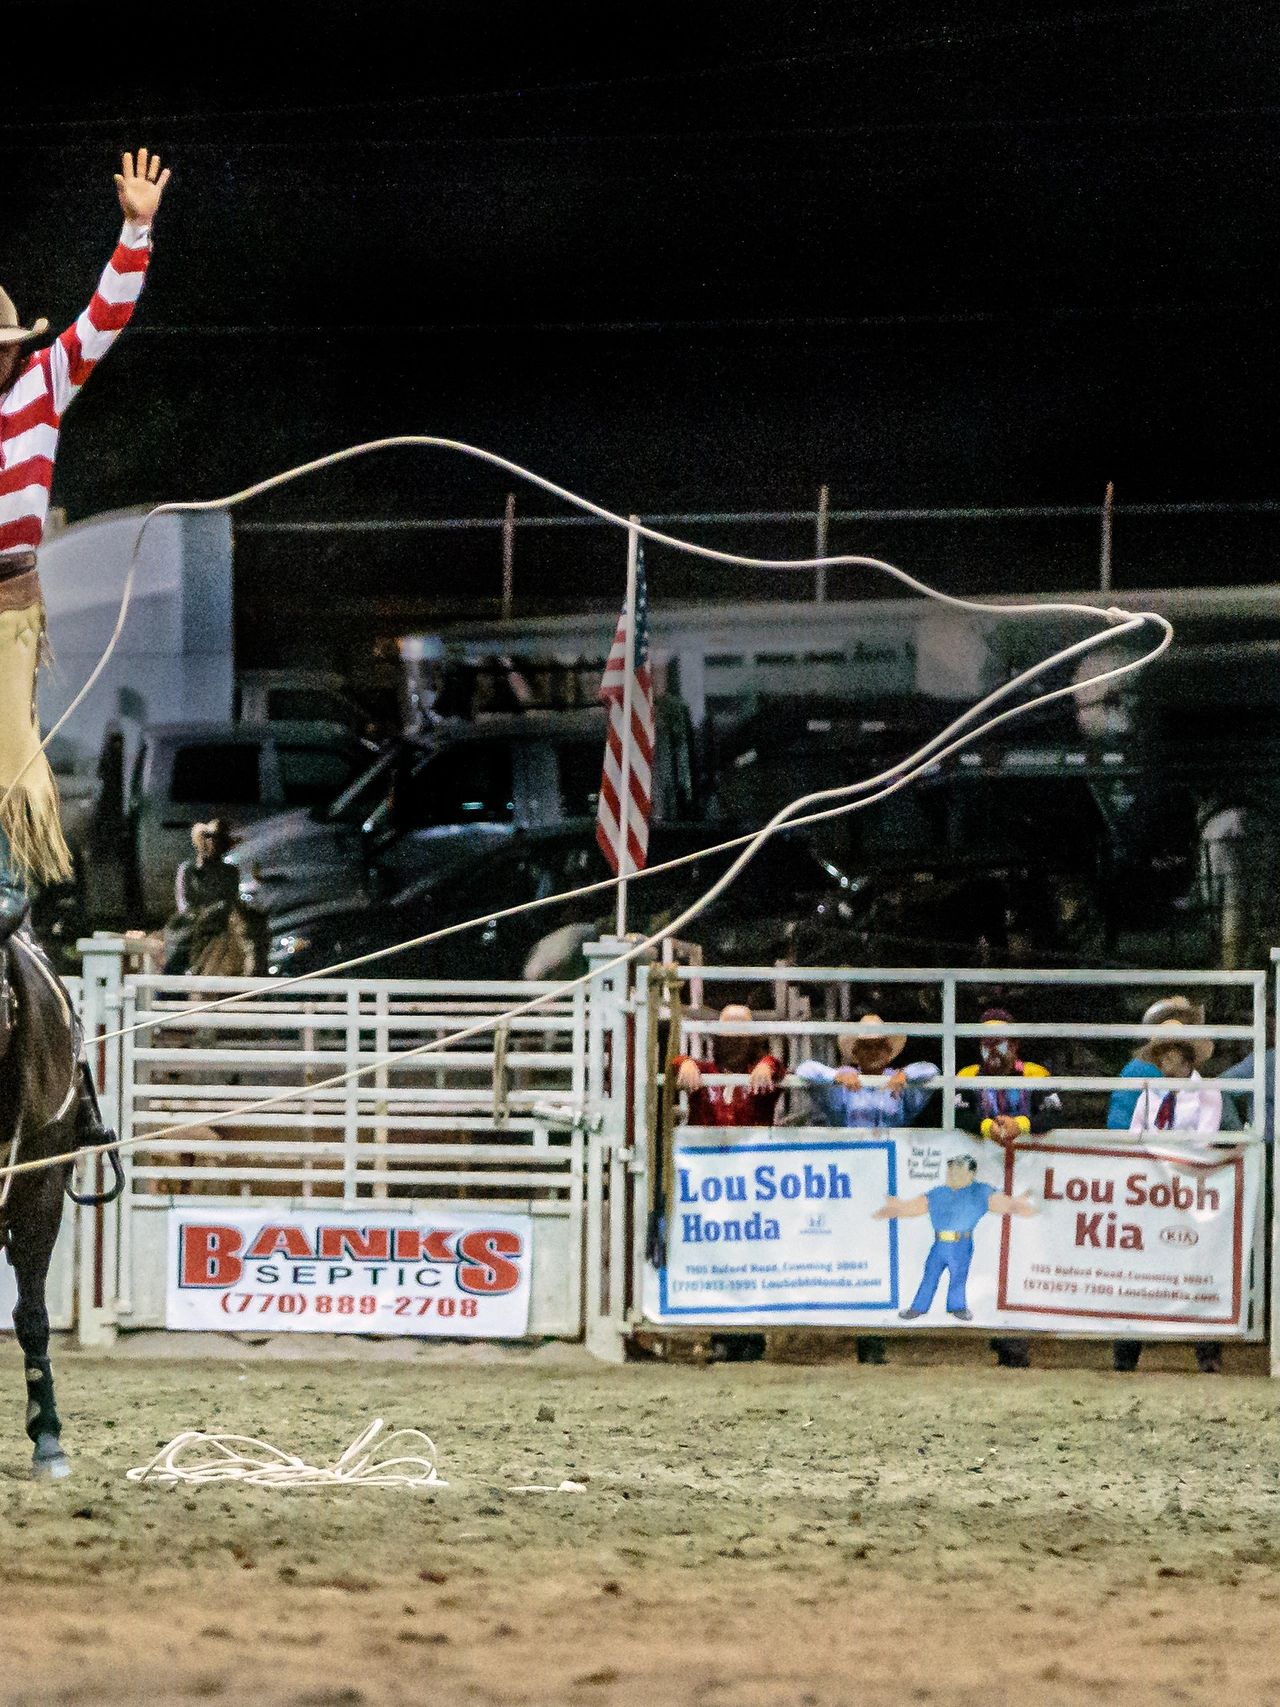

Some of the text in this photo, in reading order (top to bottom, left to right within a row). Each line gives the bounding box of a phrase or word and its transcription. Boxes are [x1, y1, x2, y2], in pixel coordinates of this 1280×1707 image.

[678, 1163, 852, 1203] Lou Sobh
[1042, 1167, 1220, 1212] Lou Sobh
[681, 1211, 782, 1243] Honda
[1074, 1210, 1145, 1251] Kia
[177, 1223, 523, 1297] BANKS
[255, 1264, 443, 1287] SEPTIC
